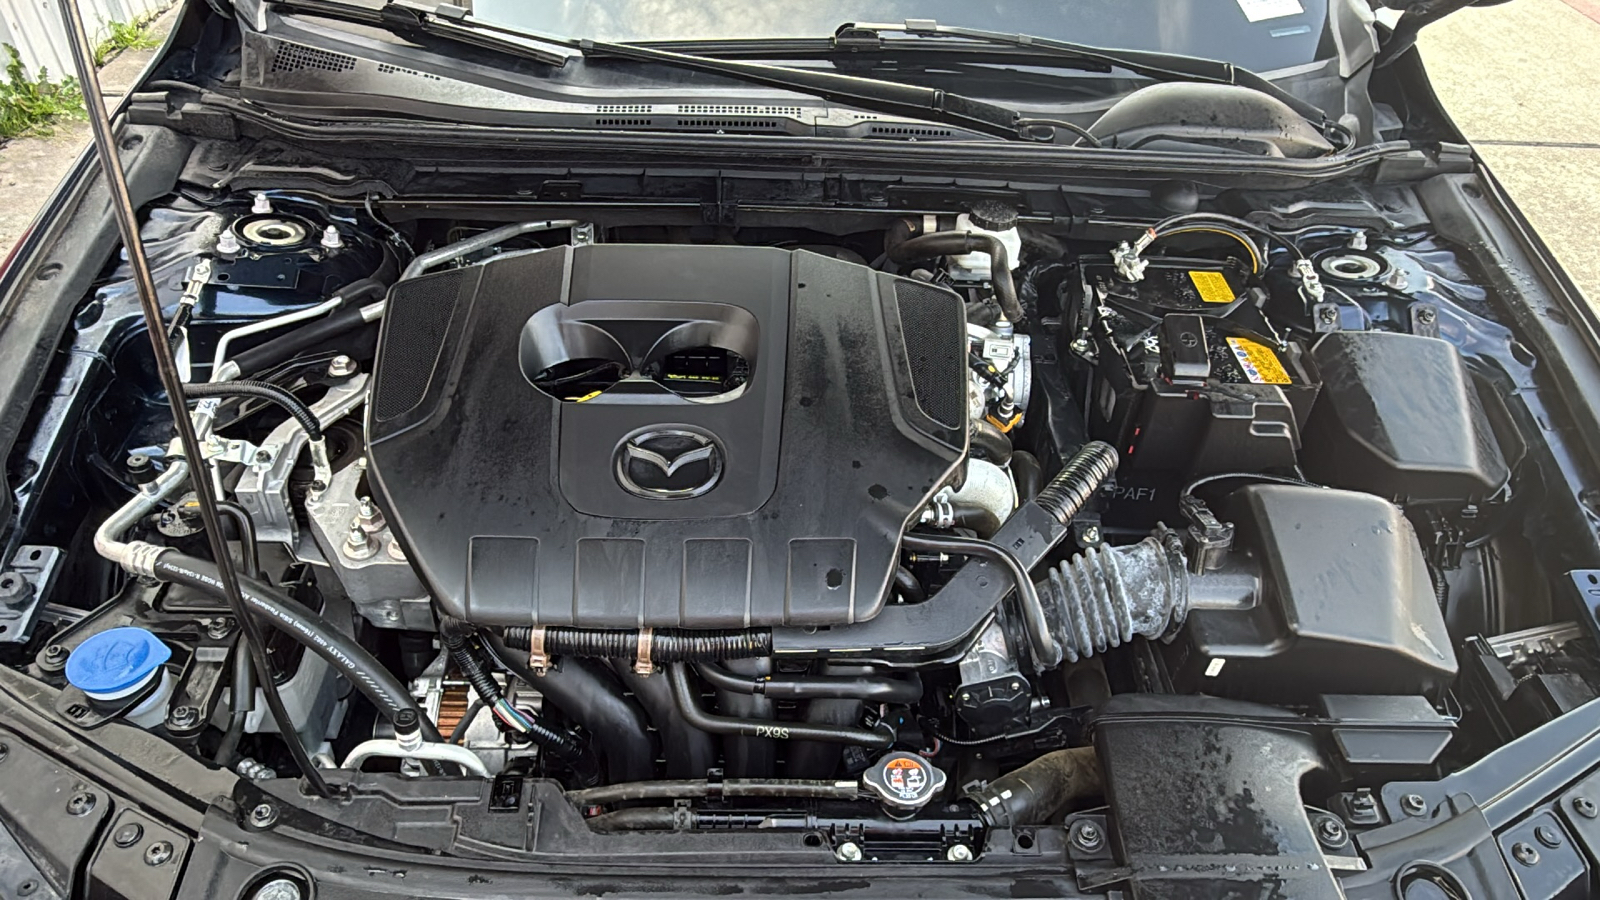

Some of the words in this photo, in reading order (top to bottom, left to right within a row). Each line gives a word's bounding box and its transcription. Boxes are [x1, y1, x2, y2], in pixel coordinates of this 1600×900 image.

[1112, 486, 1156, 502] PAF1
[200, 574, 216, 585] HOSE
[293, 620, 315, 638] (16mm)
[327, 645, 356, 669] GALAXY
[756, 725, 789, 739] PX9S
